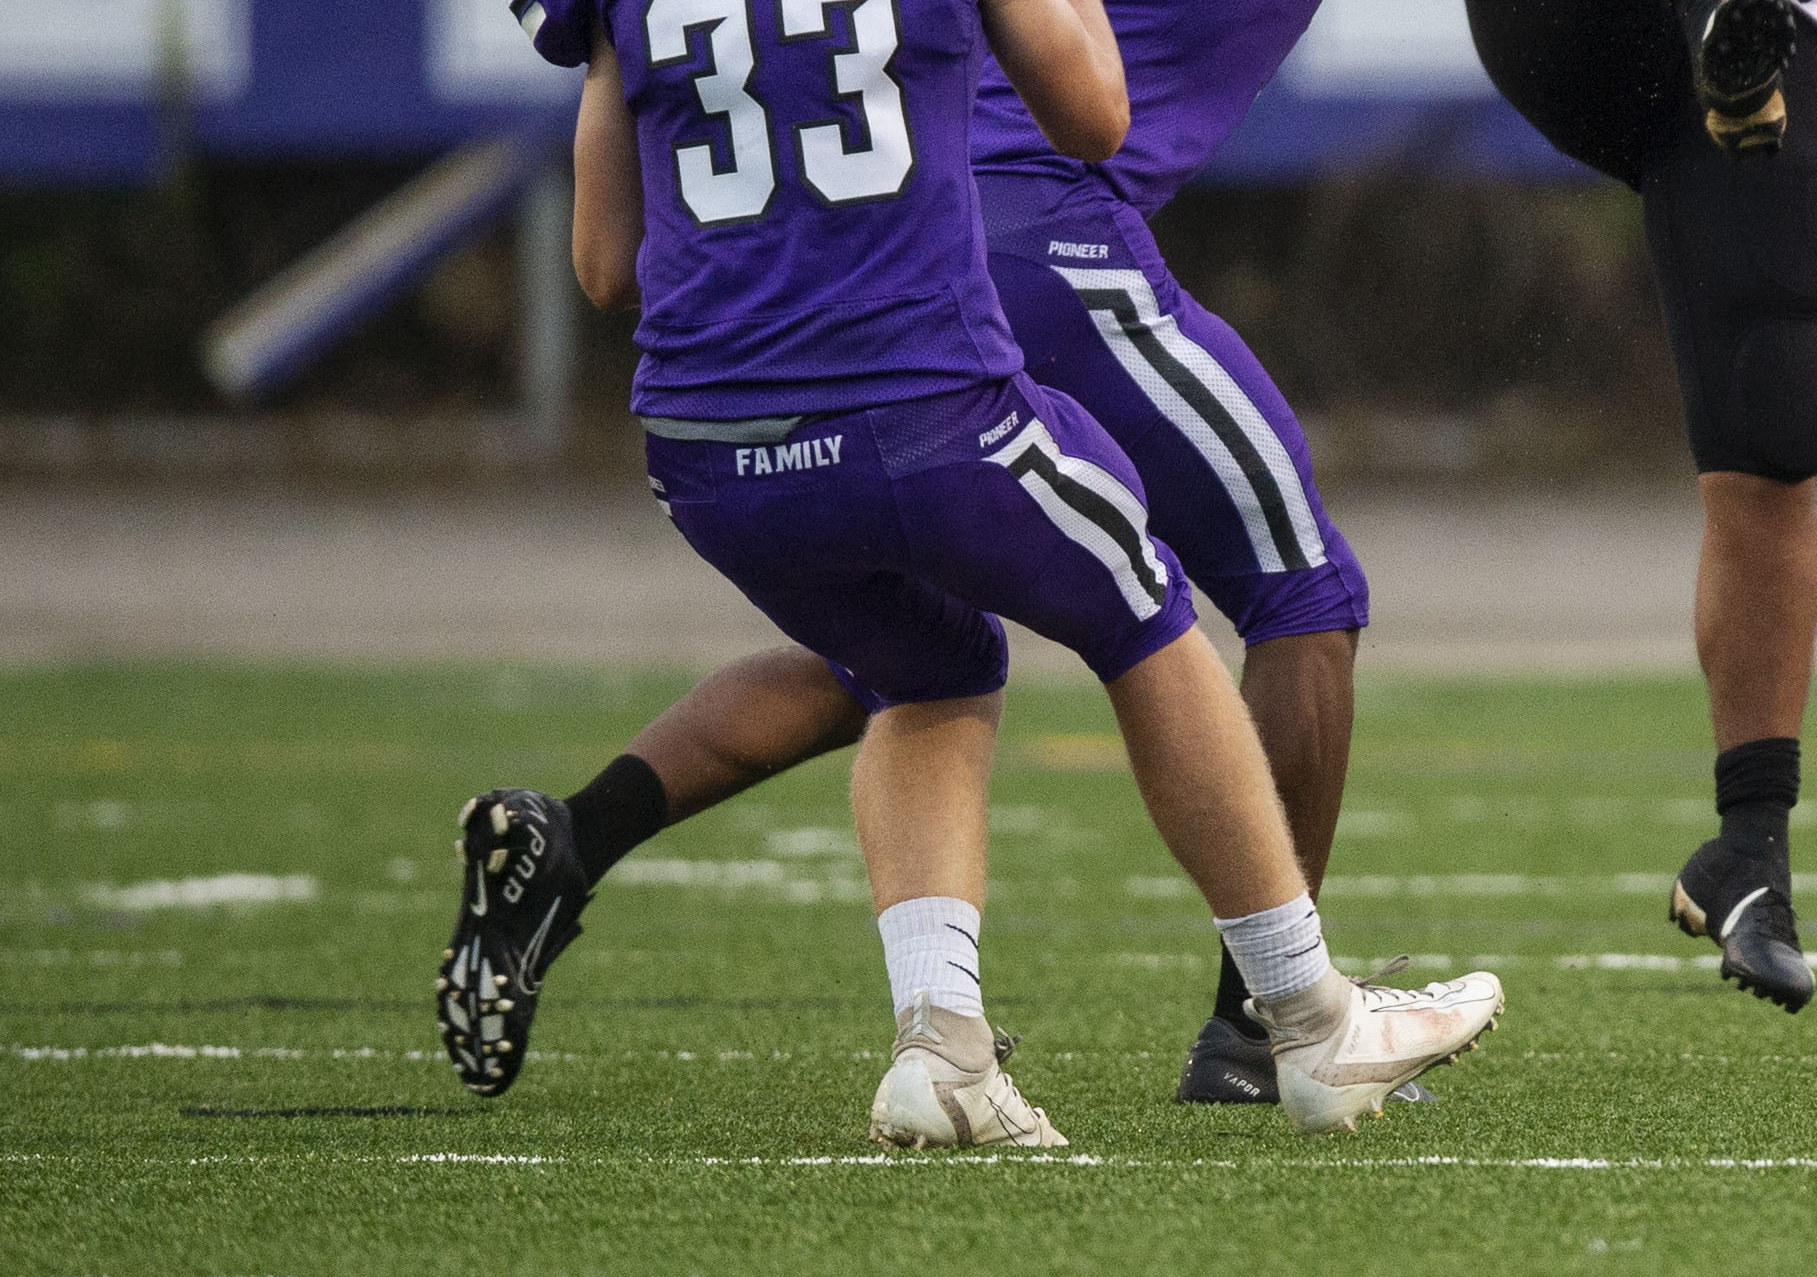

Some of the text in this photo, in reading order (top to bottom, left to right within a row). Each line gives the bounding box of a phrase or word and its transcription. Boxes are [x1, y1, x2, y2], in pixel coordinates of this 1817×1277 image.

[1047, 240, 1109, 259] PIONEER
[979, 410, 1019, 448] PIONEER
[736, 435, 844, 477] FAMILY
[1223, 1071, 1261, 1098] VAPOR
